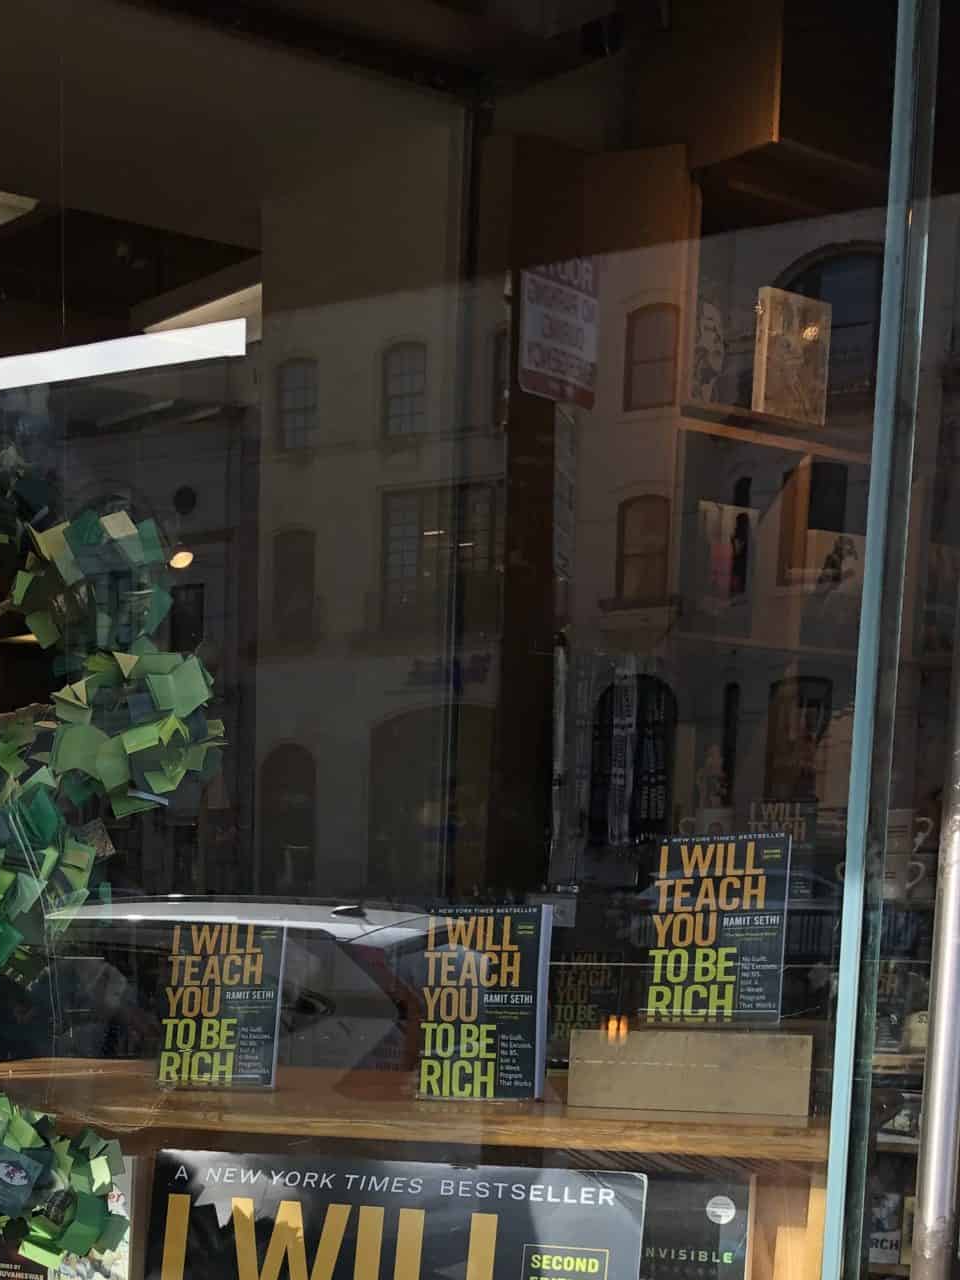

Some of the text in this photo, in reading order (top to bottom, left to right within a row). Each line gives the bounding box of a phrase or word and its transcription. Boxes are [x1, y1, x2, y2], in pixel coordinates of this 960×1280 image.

[659, 841, 765, 879] I WILL
[655, 876, 767, 913] TEACH
[172, 923, 262, 955] I WILL
[427, 915, 518, 951] I WILL
[653, 912, 718, 948] YOU
[723, 914, 780, 928] RAMIT SETHI
[168, 953, 264, 986] TEACH
[424, 950, 521, 987] TEACH
[649, 947, 737, 984] TO BE
[165, 986, 222, 1018] YOU
[226, 991, 249, 1000] RAMIT
[422, 986, 479, 1023] YOU
[483, 993, 533, 1005] RAMIT SETHI
[647, 984, 734, 1022] RICH
[162, 1018, 196, 1051] TO
[200, 1018, 237, 1050] BE
[420, 1023, 497, 1059] TO BE
[159, 1051, 235, 1087] RICH
[420, 1058, 496, 1098] RICH
[174, 1164, 616, 1207] A NEW YORK TIMES BESTSELLER
[530, 1254, 600, 1274] SECOND
[645, 1247, 734, 1264] NVISIBLE
